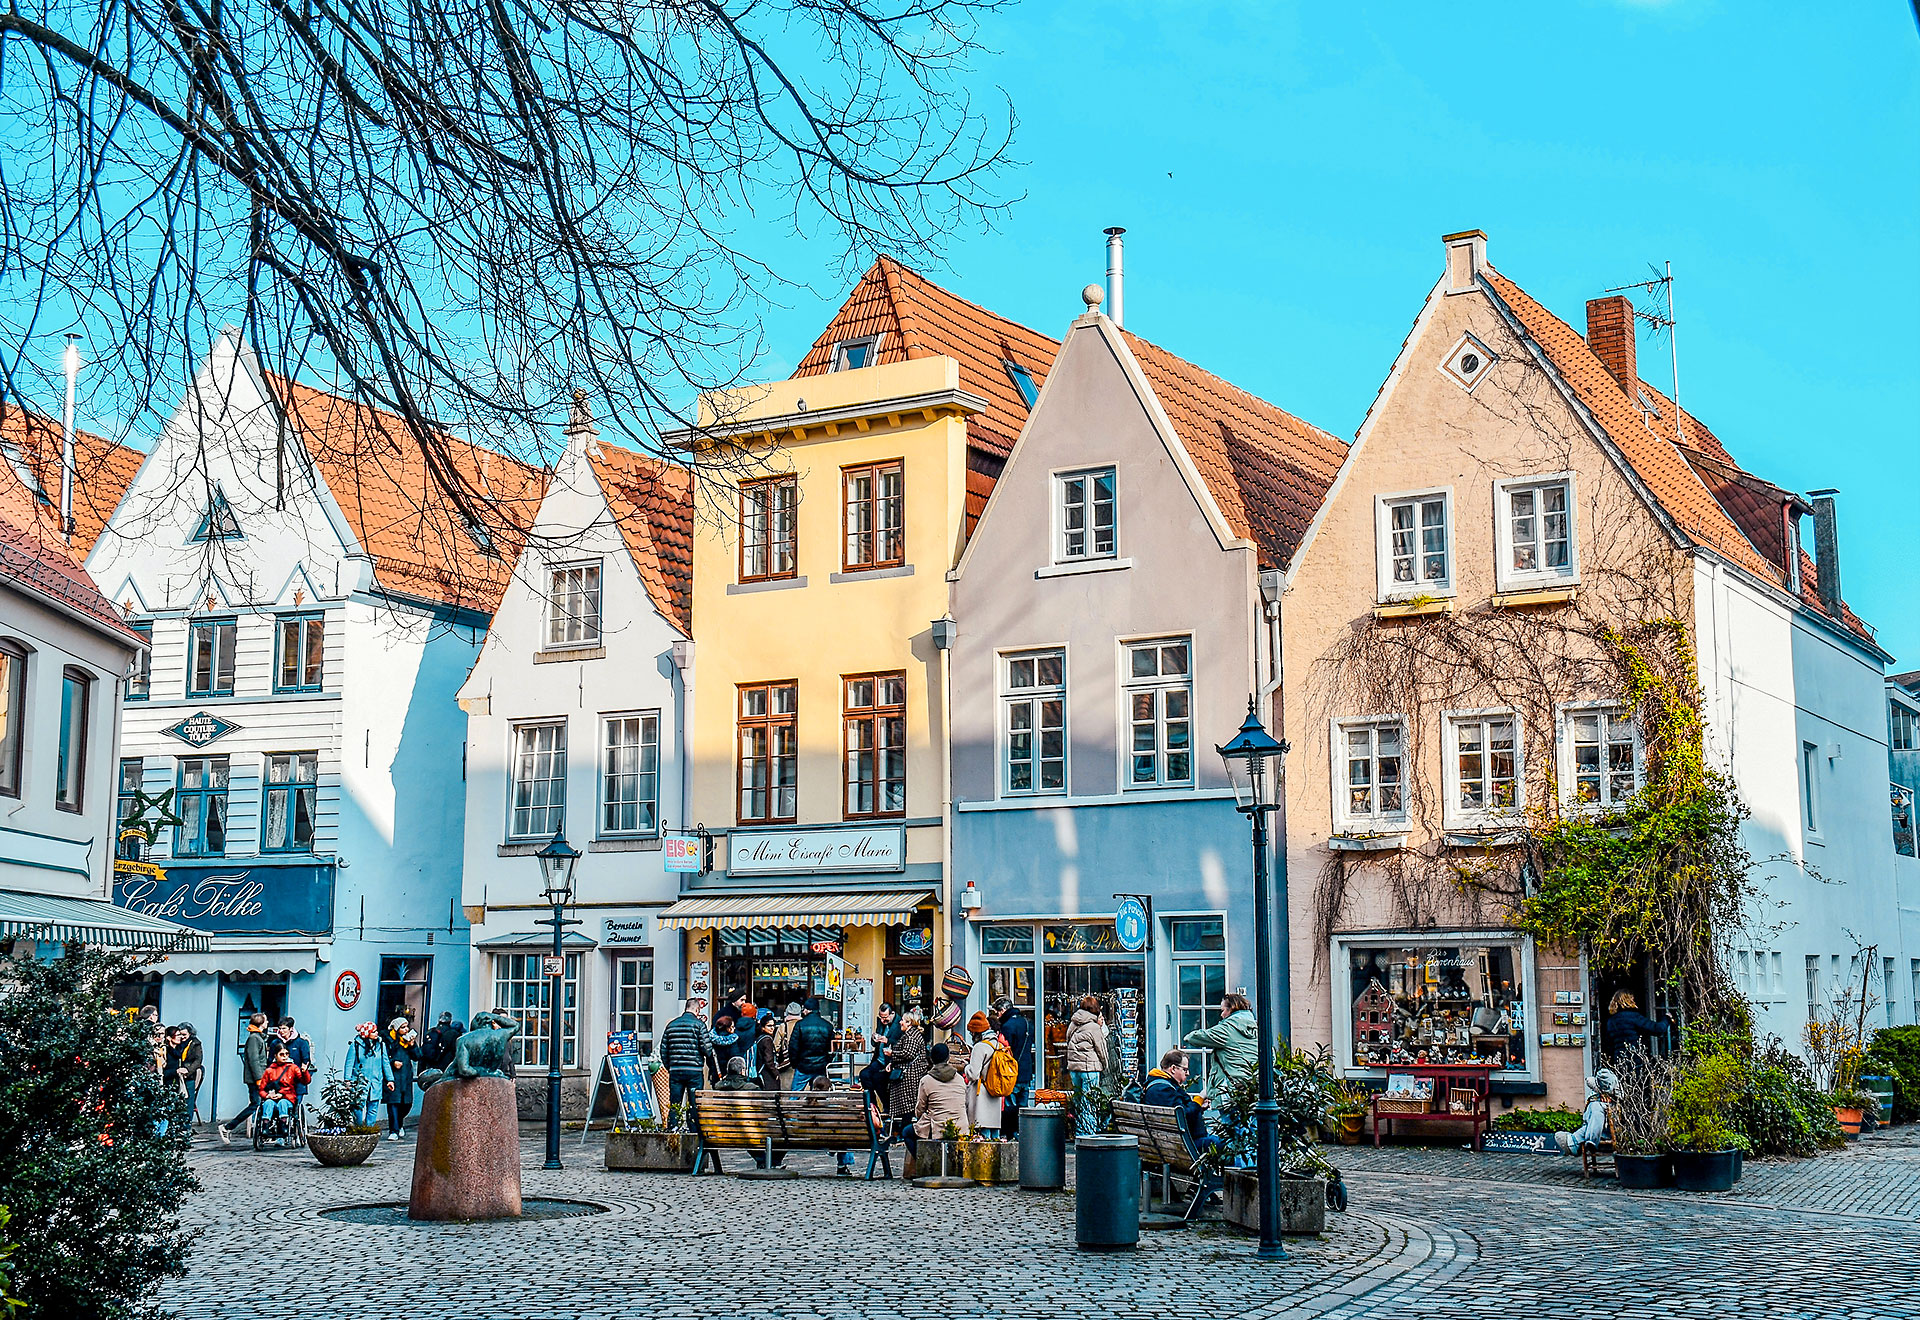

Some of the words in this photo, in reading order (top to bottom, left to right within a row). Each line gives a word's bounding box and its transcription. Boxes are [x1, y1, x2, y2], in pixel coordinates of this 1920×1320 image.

[189, 717, 212, 725] HAUTE
[183, 725, 217, 734] COUTURE
[666, 840, 685, 857] EIS
[738, 839, 784, 861] Mini
[788, 837, 833, 865] Eiscafé
[838, 836, 893, 858] Mario
[122, 880, 189, 918] Café
[182, 871, 264, 919] Tölke
[605, 919, 643, 930] Bernstein
[607, 932, 641, 942] Zimmer
[905, 931, 920, 944] Eis
[1061, 929, 1087, 951] Die
[812, 941, 840, 954] OPEN
[826, 990, 840, 1001] EIS
